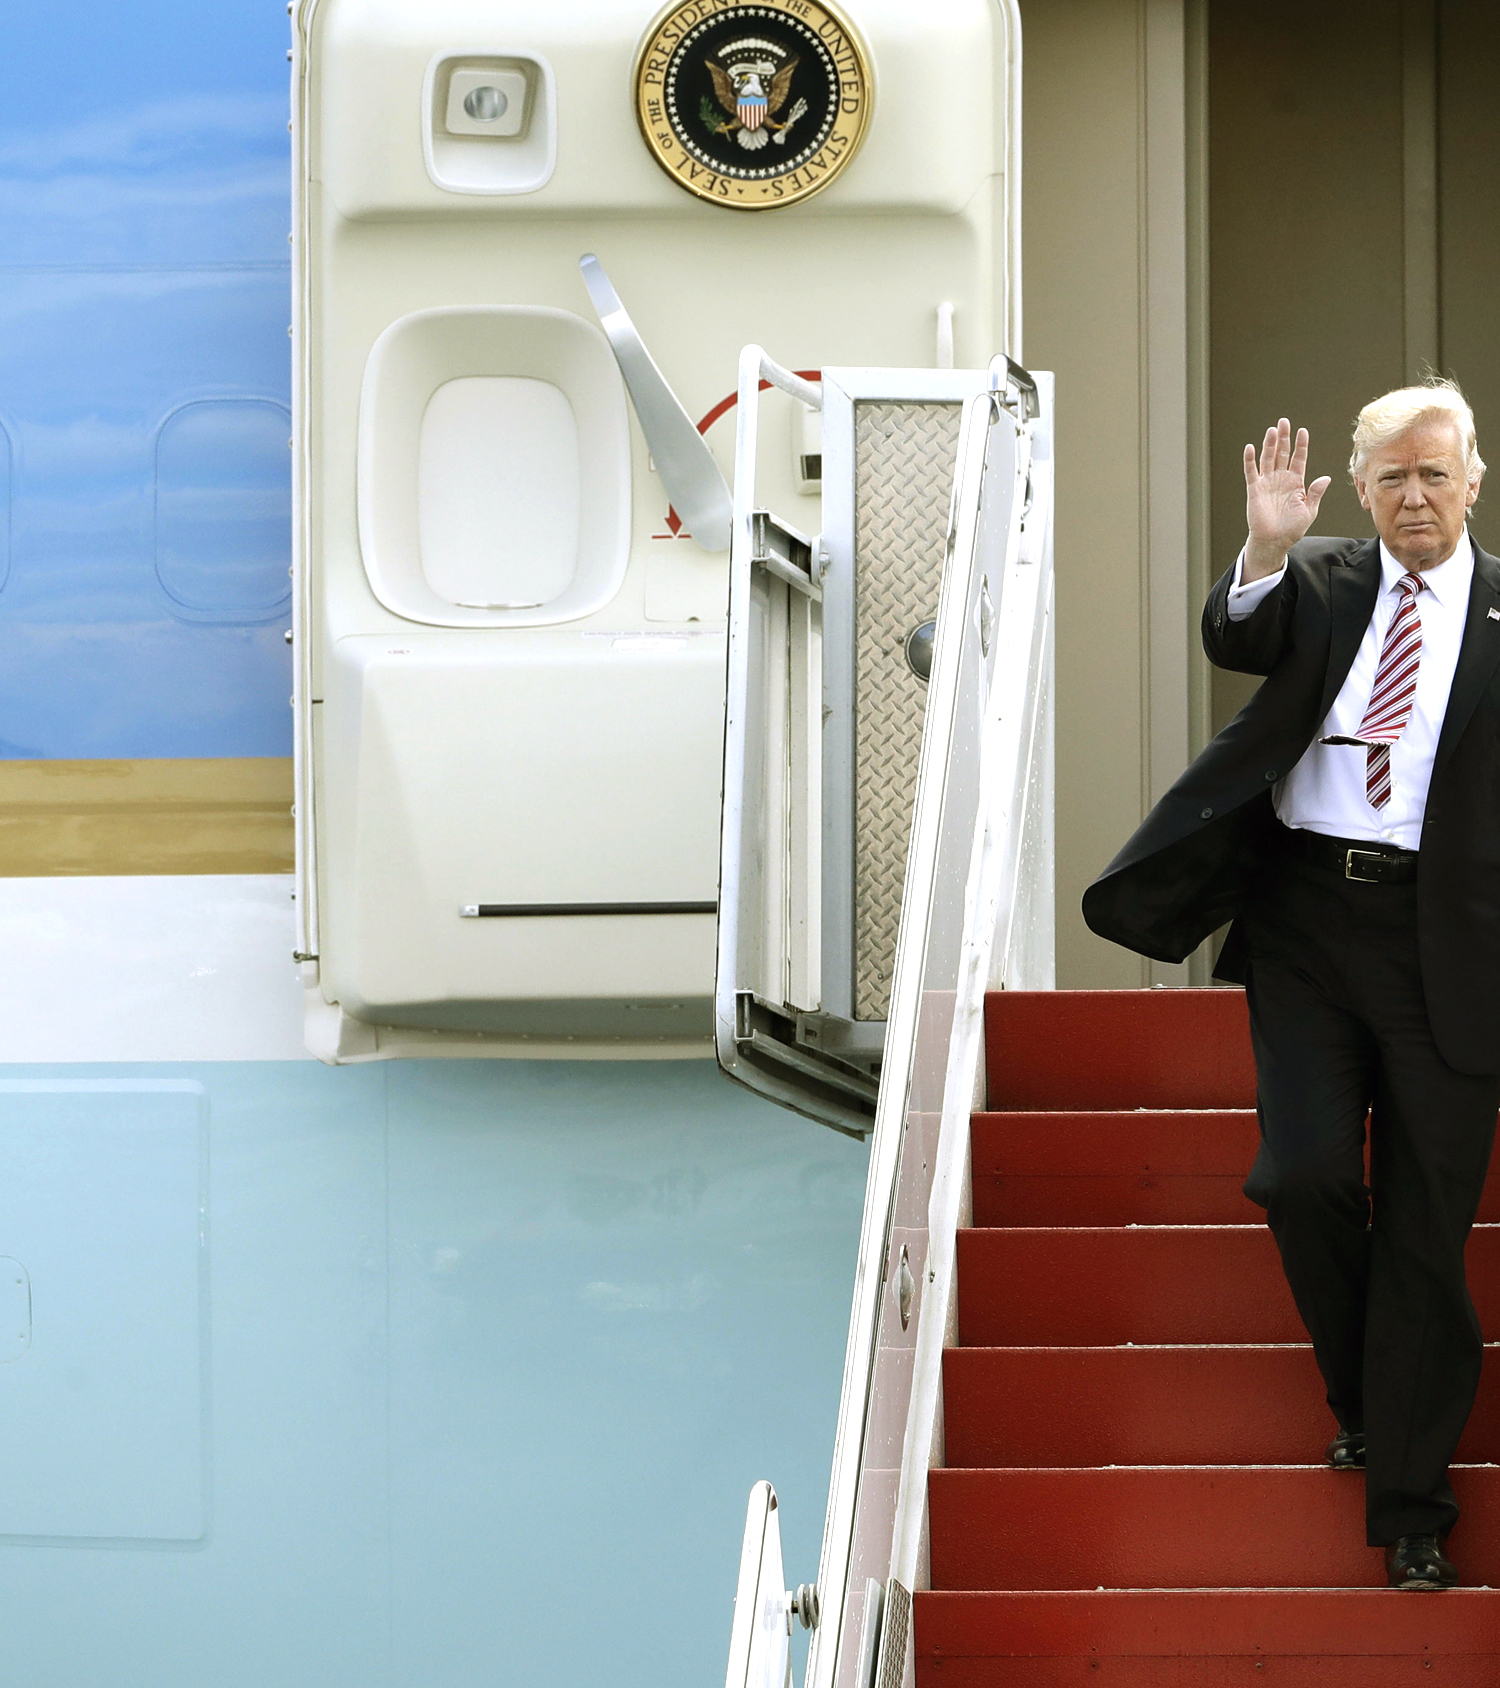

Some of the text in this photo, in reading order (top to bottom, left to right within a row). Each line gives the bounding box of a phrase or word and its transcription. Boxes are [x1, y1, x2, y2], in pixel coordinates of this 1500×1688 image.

[644, 0, 740, 85] PRESIDE
[818, 19, 859, 114] UNITED
[647, 98, 663, 125] THE
[657, 132, 673, 149] OF
[771, 130, 848, 197] STATES
[676, 151, 732, 196] SEAL
